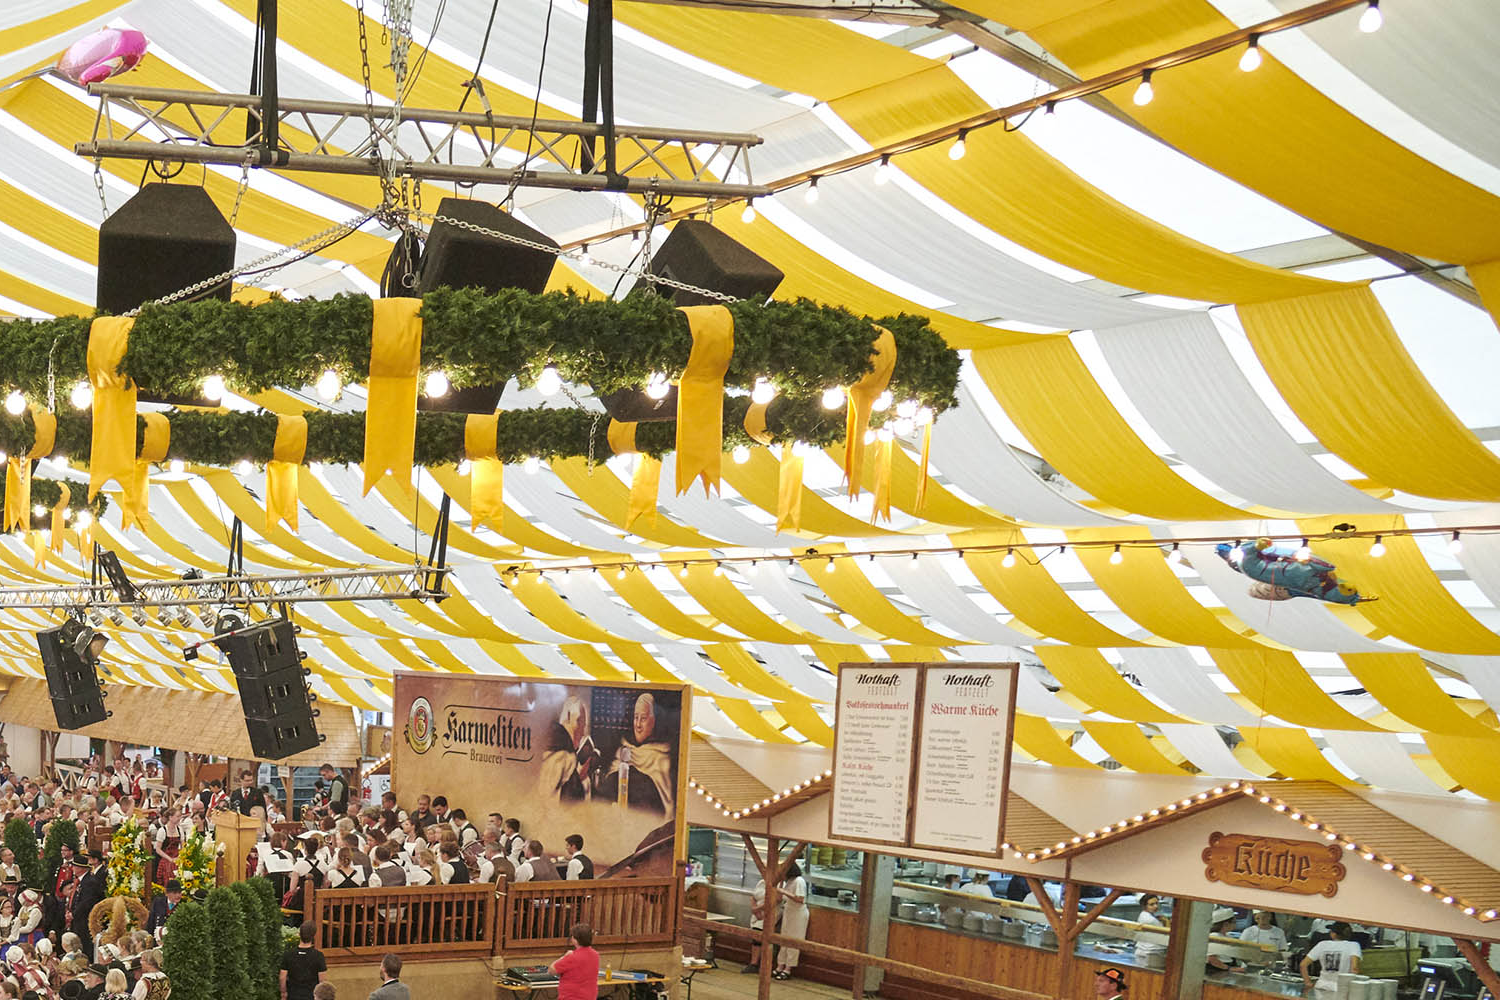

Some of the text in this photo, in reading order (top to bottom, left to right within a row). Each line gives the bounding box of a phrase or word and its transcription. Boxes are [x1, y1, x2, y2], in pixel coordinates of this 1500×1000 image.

[855, 673, 901, 687] Nothaft
[943, 674, 995, 688] Nothaft
[931, 703, 999, 717] Warme Küche
[442, 711, 532, 751] Karmeliten
[470, 748, 503, 765] Brauerei
[1233, 842, 1311, 884] Küche
